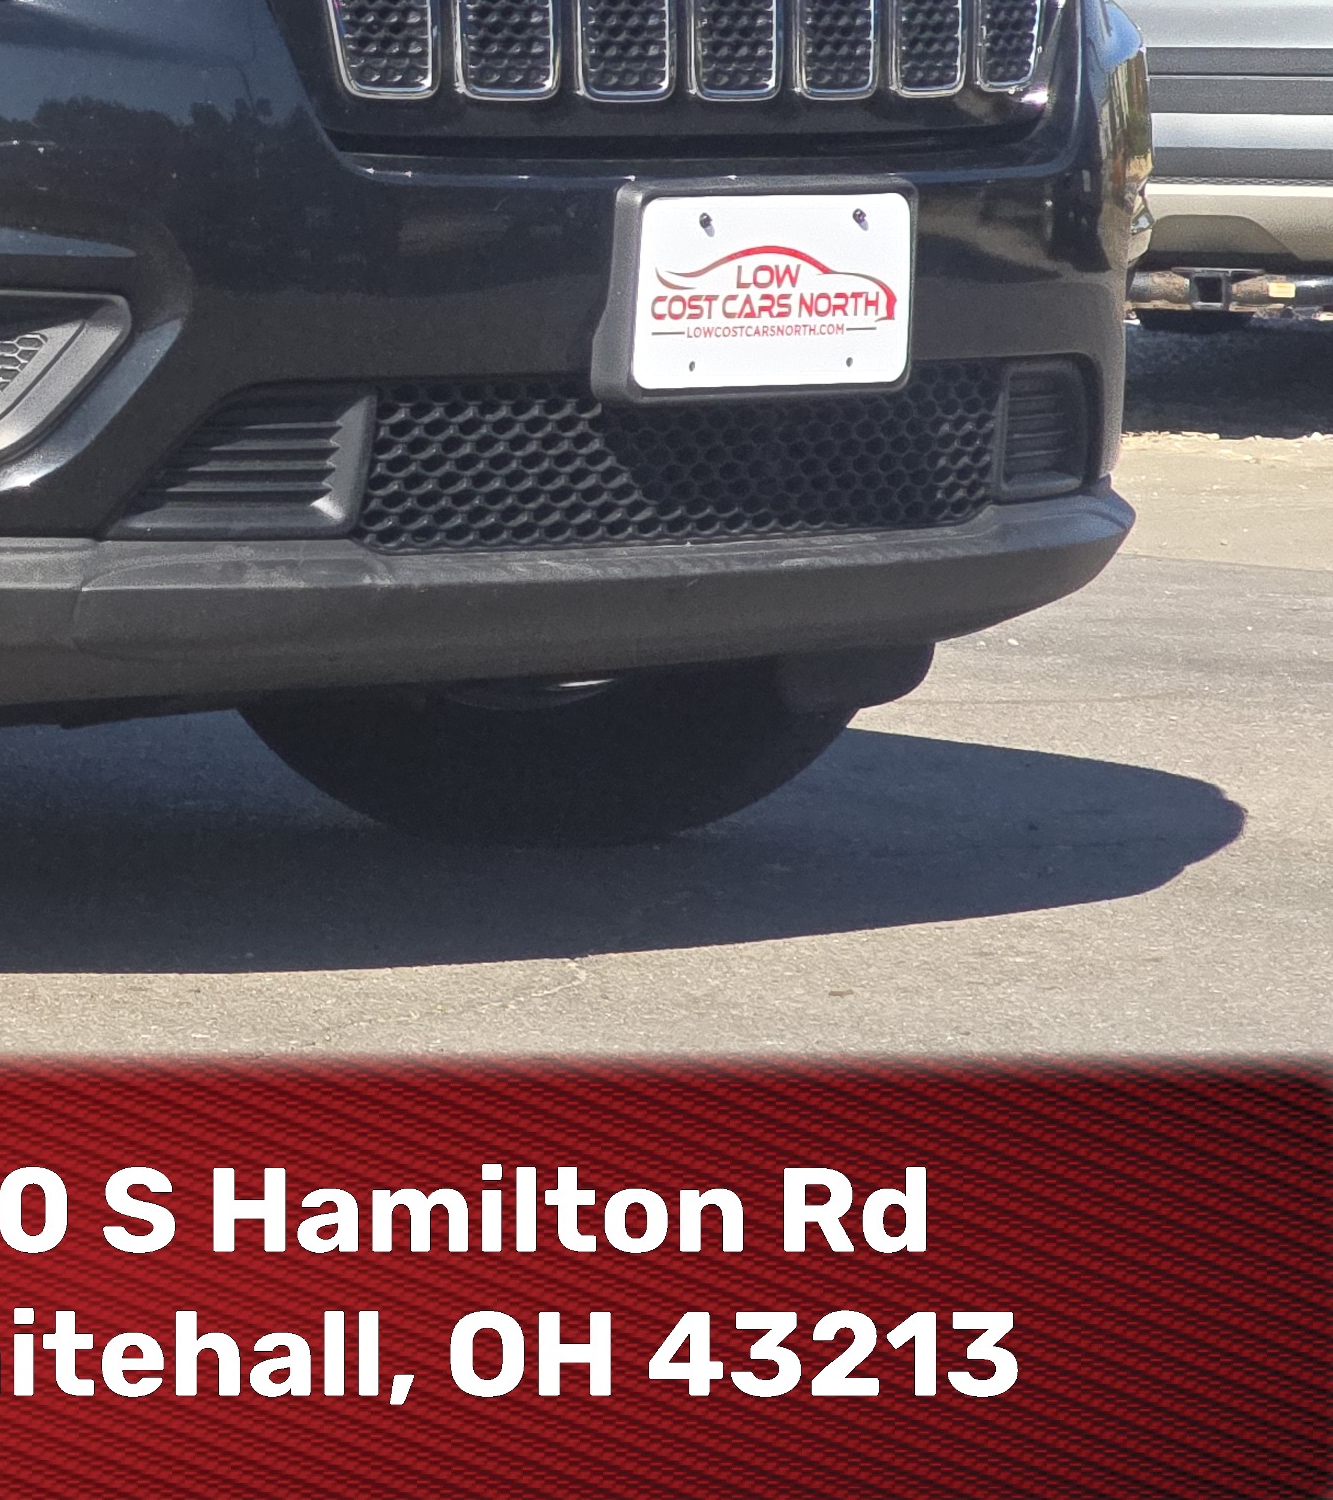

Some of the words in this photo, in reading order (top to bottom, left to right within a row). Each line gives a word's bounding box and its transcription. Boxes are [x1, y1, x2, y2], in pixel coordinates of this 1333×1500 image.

[736, 264, 802, 289] LOW
[650, 294, 720, 320] COST
[721, 293, 793, 319] CARS
[798, 291, 880, 318] NORTH
[686, 323, 845, 339] LOWCOSTCARSNORTH.COM
